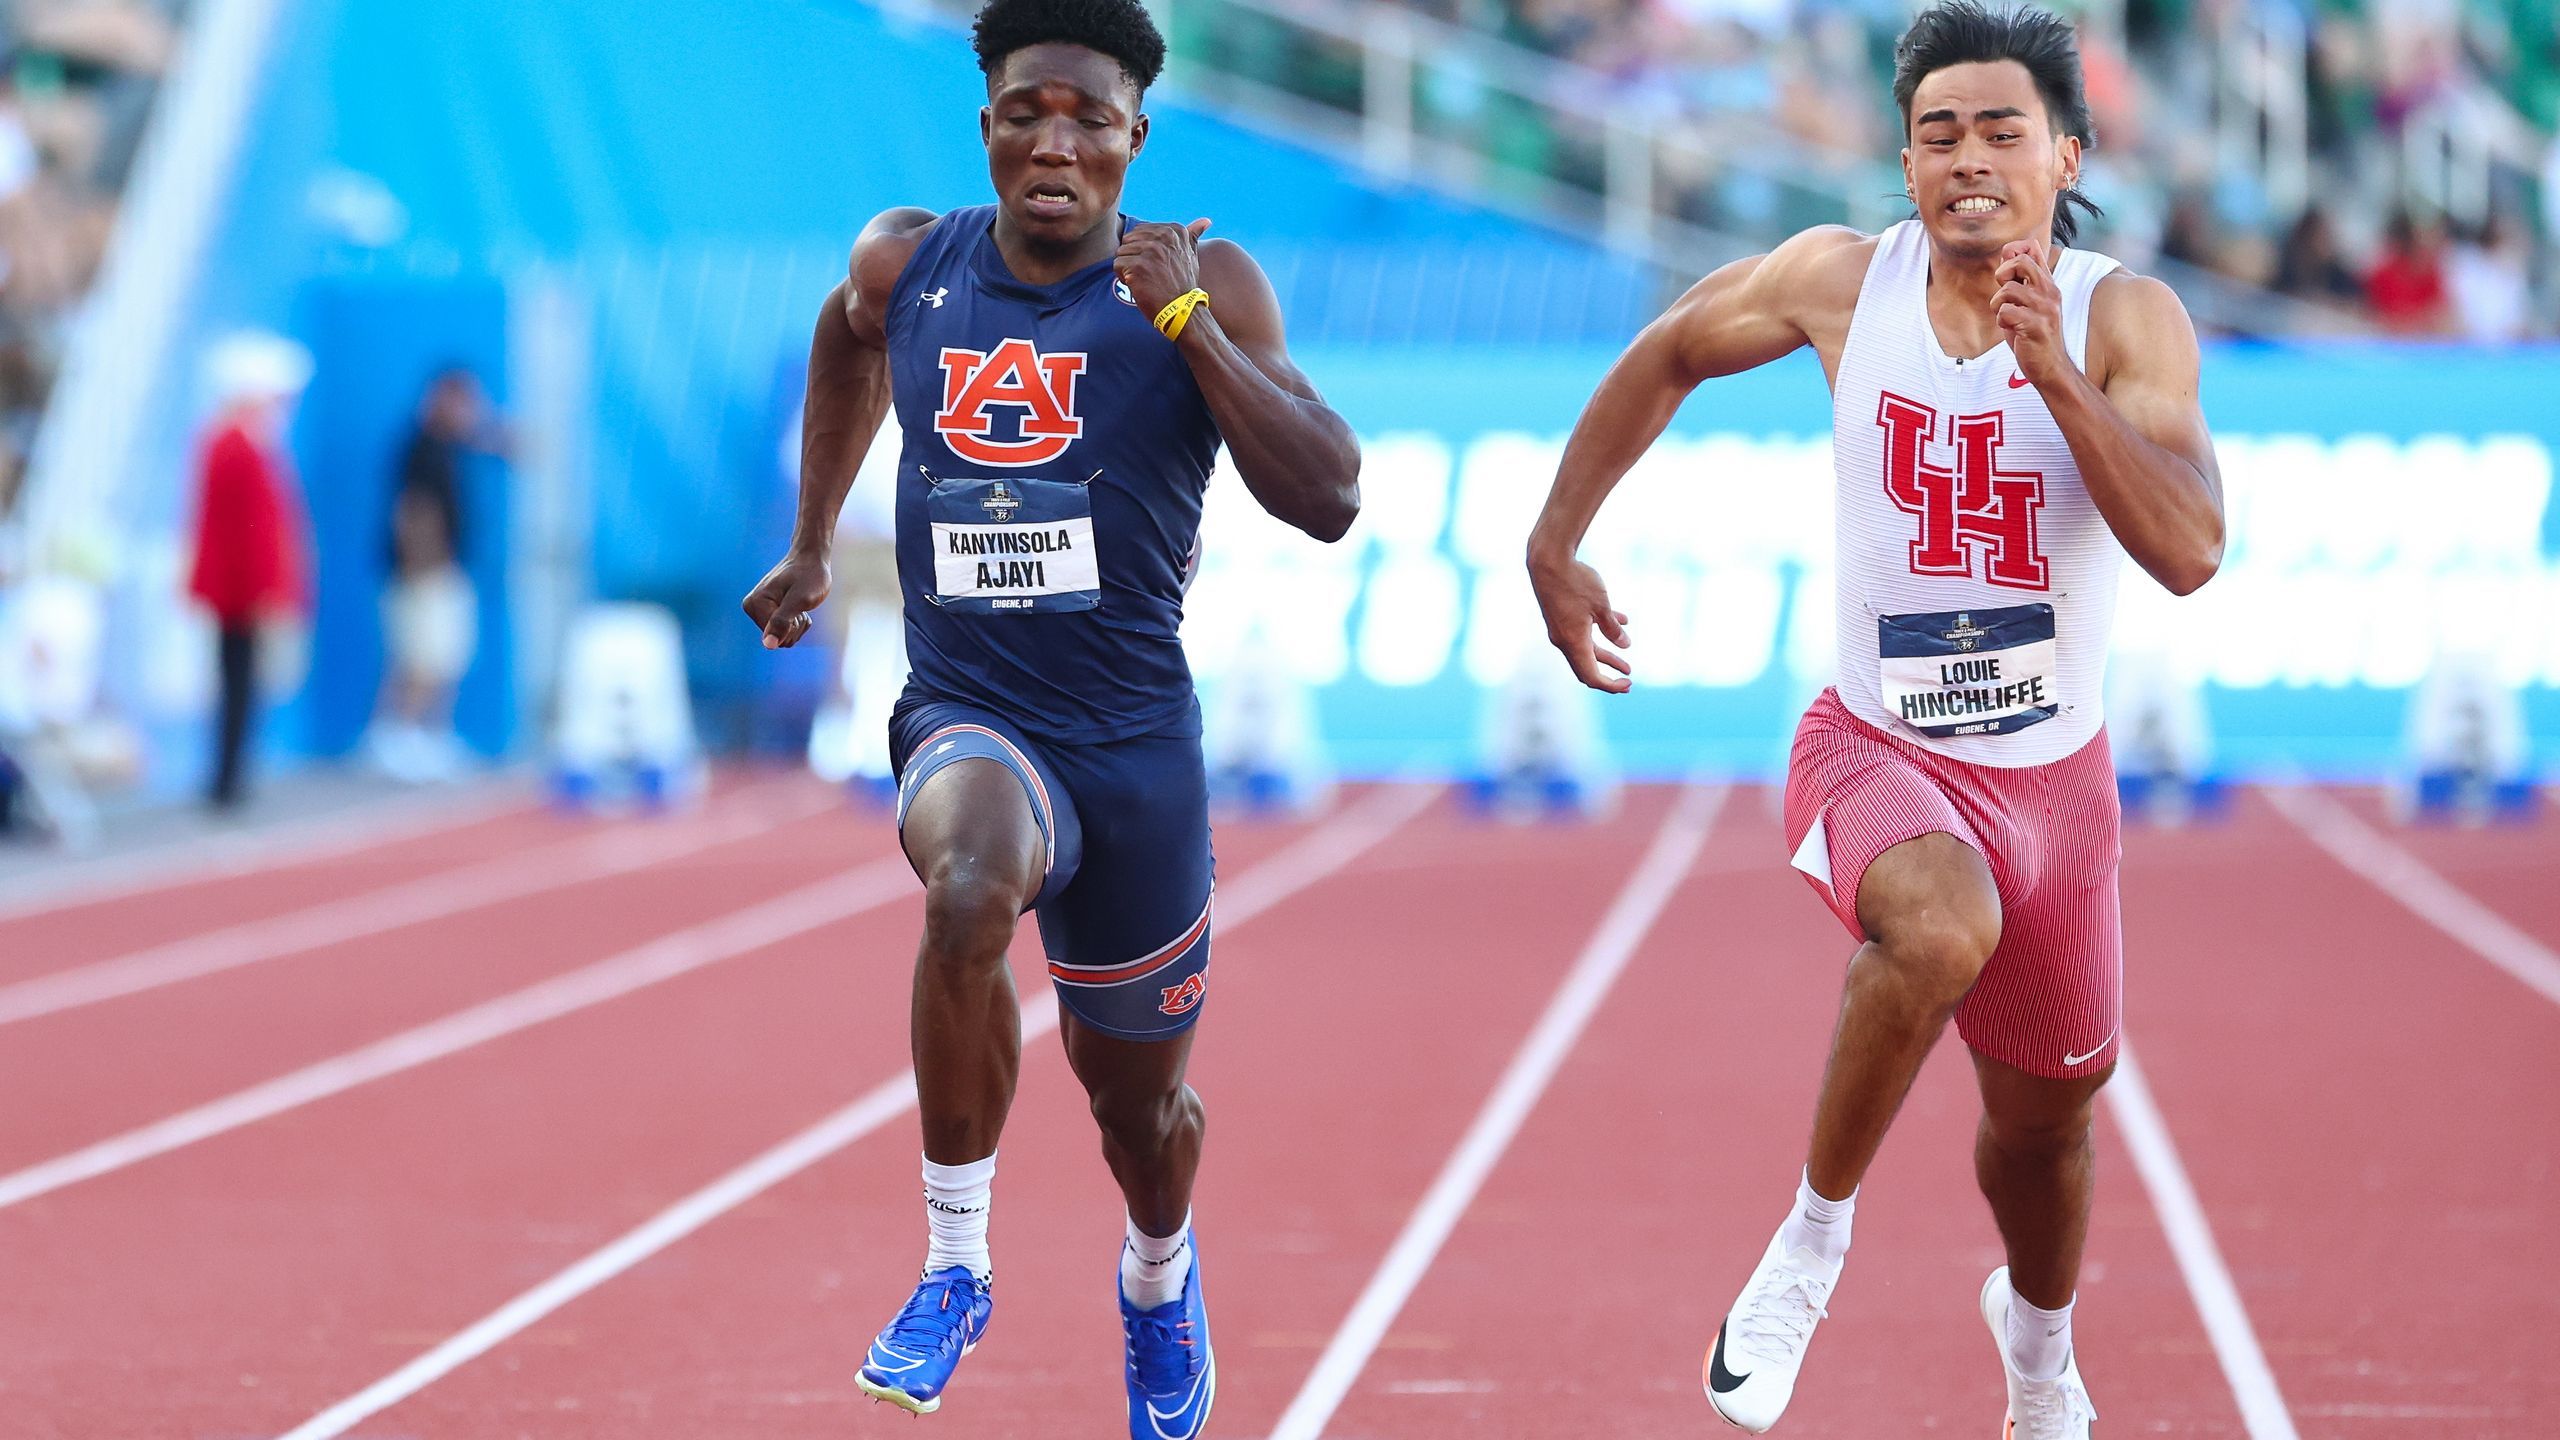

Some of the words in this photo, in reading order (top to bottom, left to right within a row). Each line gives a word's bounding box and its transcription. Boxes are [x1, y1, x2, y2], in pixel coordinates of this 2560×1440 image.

[1876, 390, 2050, 592] UH
[949, 529, 1072, 555] KANYINSOLA
[976, 561, 1045, 589] AJAYI
[992, 599, 1022, 609] EUGENE,
[1022, 599, 1034, 608] OR
[1940, 658, 2001, 686] LOUIE
[1900, 676, 2045, 720] HINCHLIFFE
[1954, 723, 1986, 735] EUGENE,
[1988, 721, 2000, 731] OR
